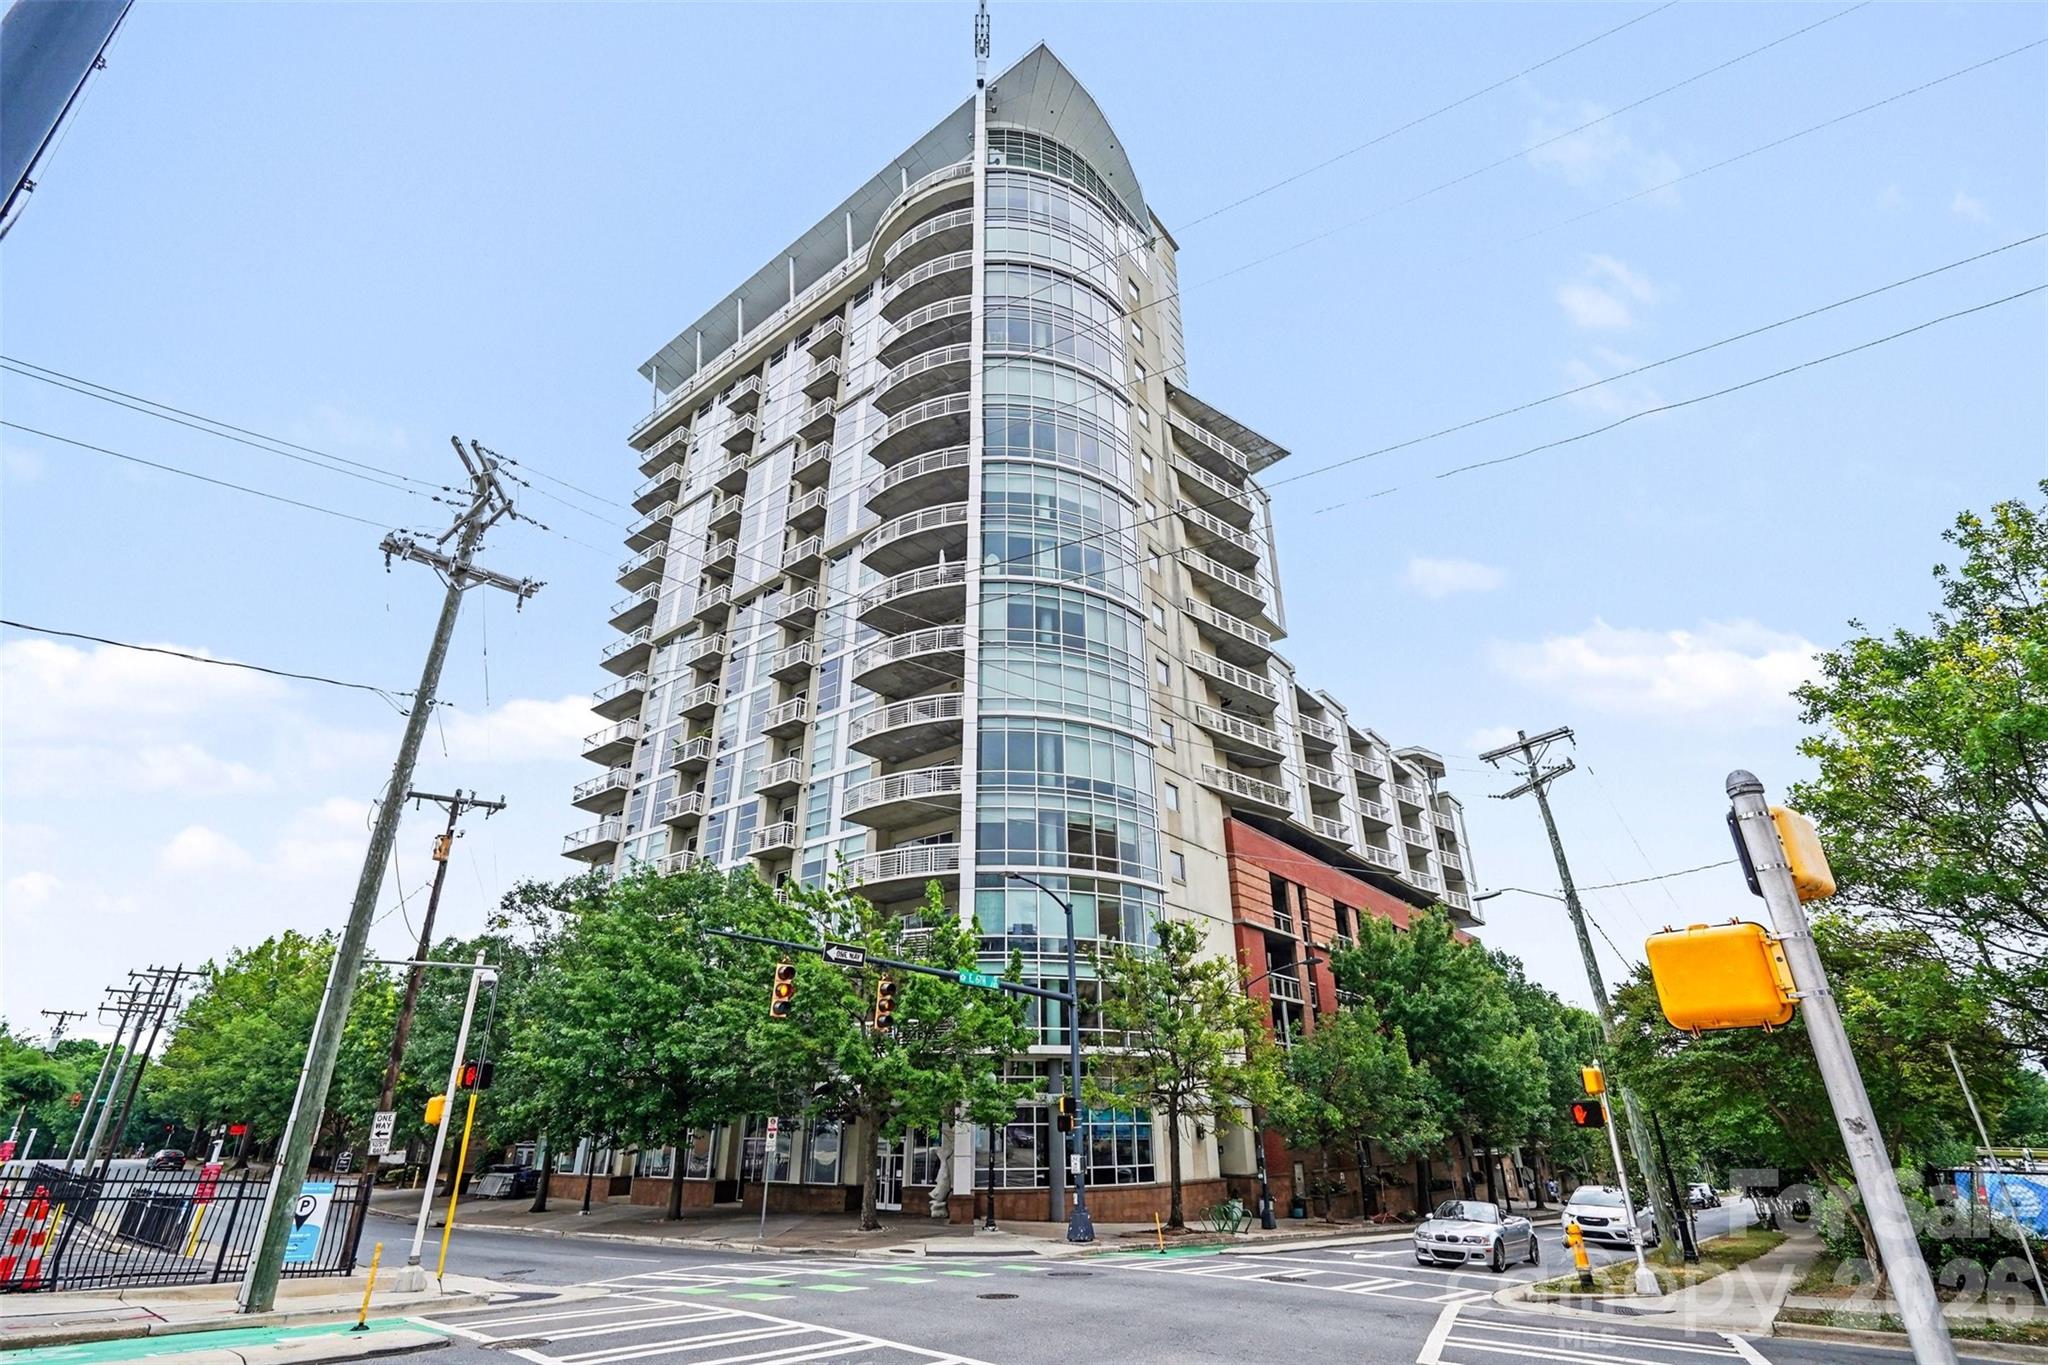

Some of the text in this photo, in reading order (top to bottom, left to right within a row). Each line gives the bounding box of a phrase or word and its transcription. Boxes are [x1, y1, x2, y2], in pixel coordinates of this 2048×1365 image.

[836, 950, 861, 960] ONE WAY
[300, 1200, 310, 1212] P
